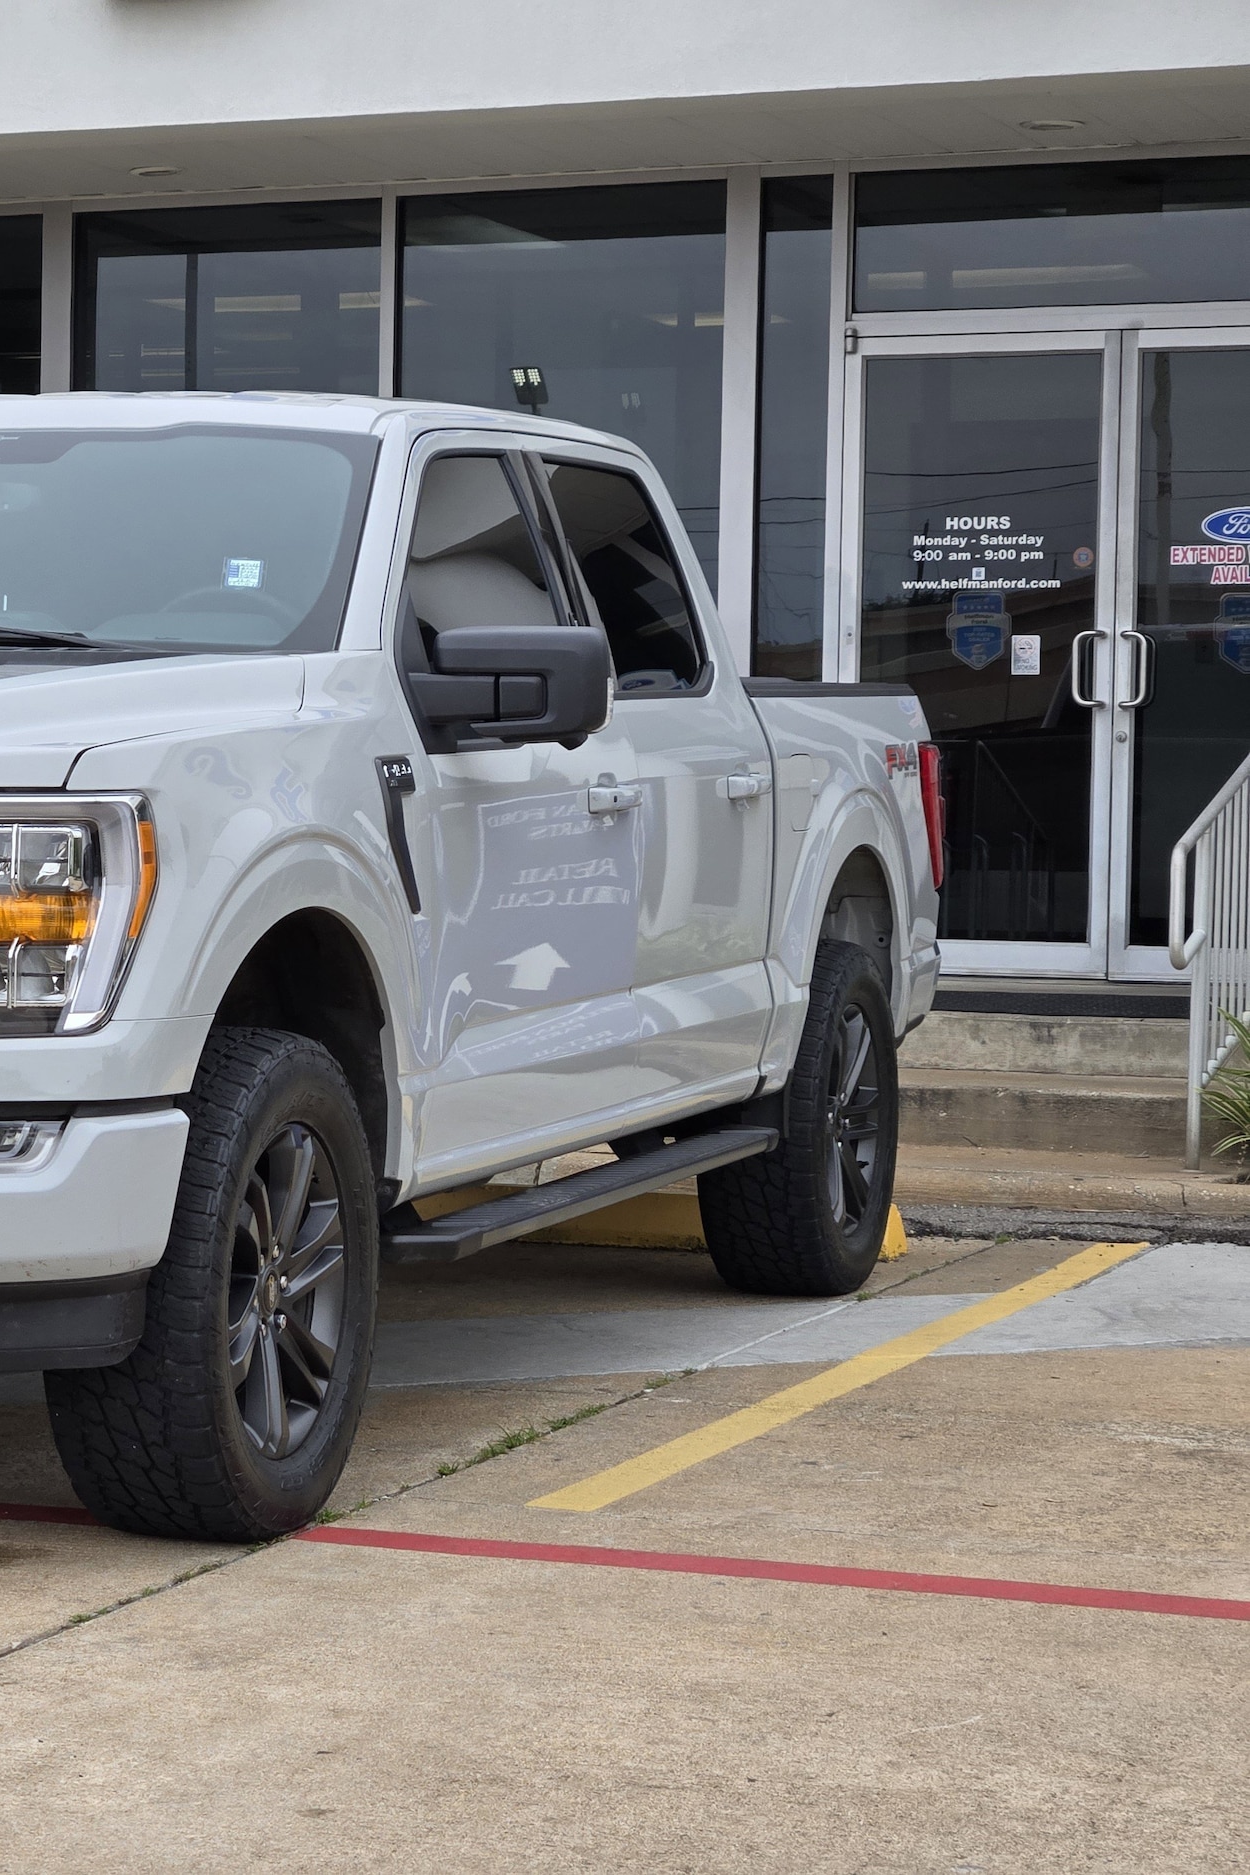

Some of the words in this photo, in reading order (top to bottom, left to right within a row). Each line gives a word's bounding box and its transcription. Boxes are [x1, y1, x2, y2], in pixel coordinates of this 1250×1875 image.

[945, 516, 1011, 530] HOURS
[913, 535, 968, 547] Monday
[979, 534, 1044, 547] Saturday
[913, 550, 943, 561] 9:00
[948, 551, 971, 560] am
[984, 549, 1016, 560] 9:00
[1020, 551, 1044, 562] pm
[1172, 547, 1244, 563] EXTENDED
[902, 578, 1061, 589] www.helfmanford.com
[885, 742, 917, 779] FX4
